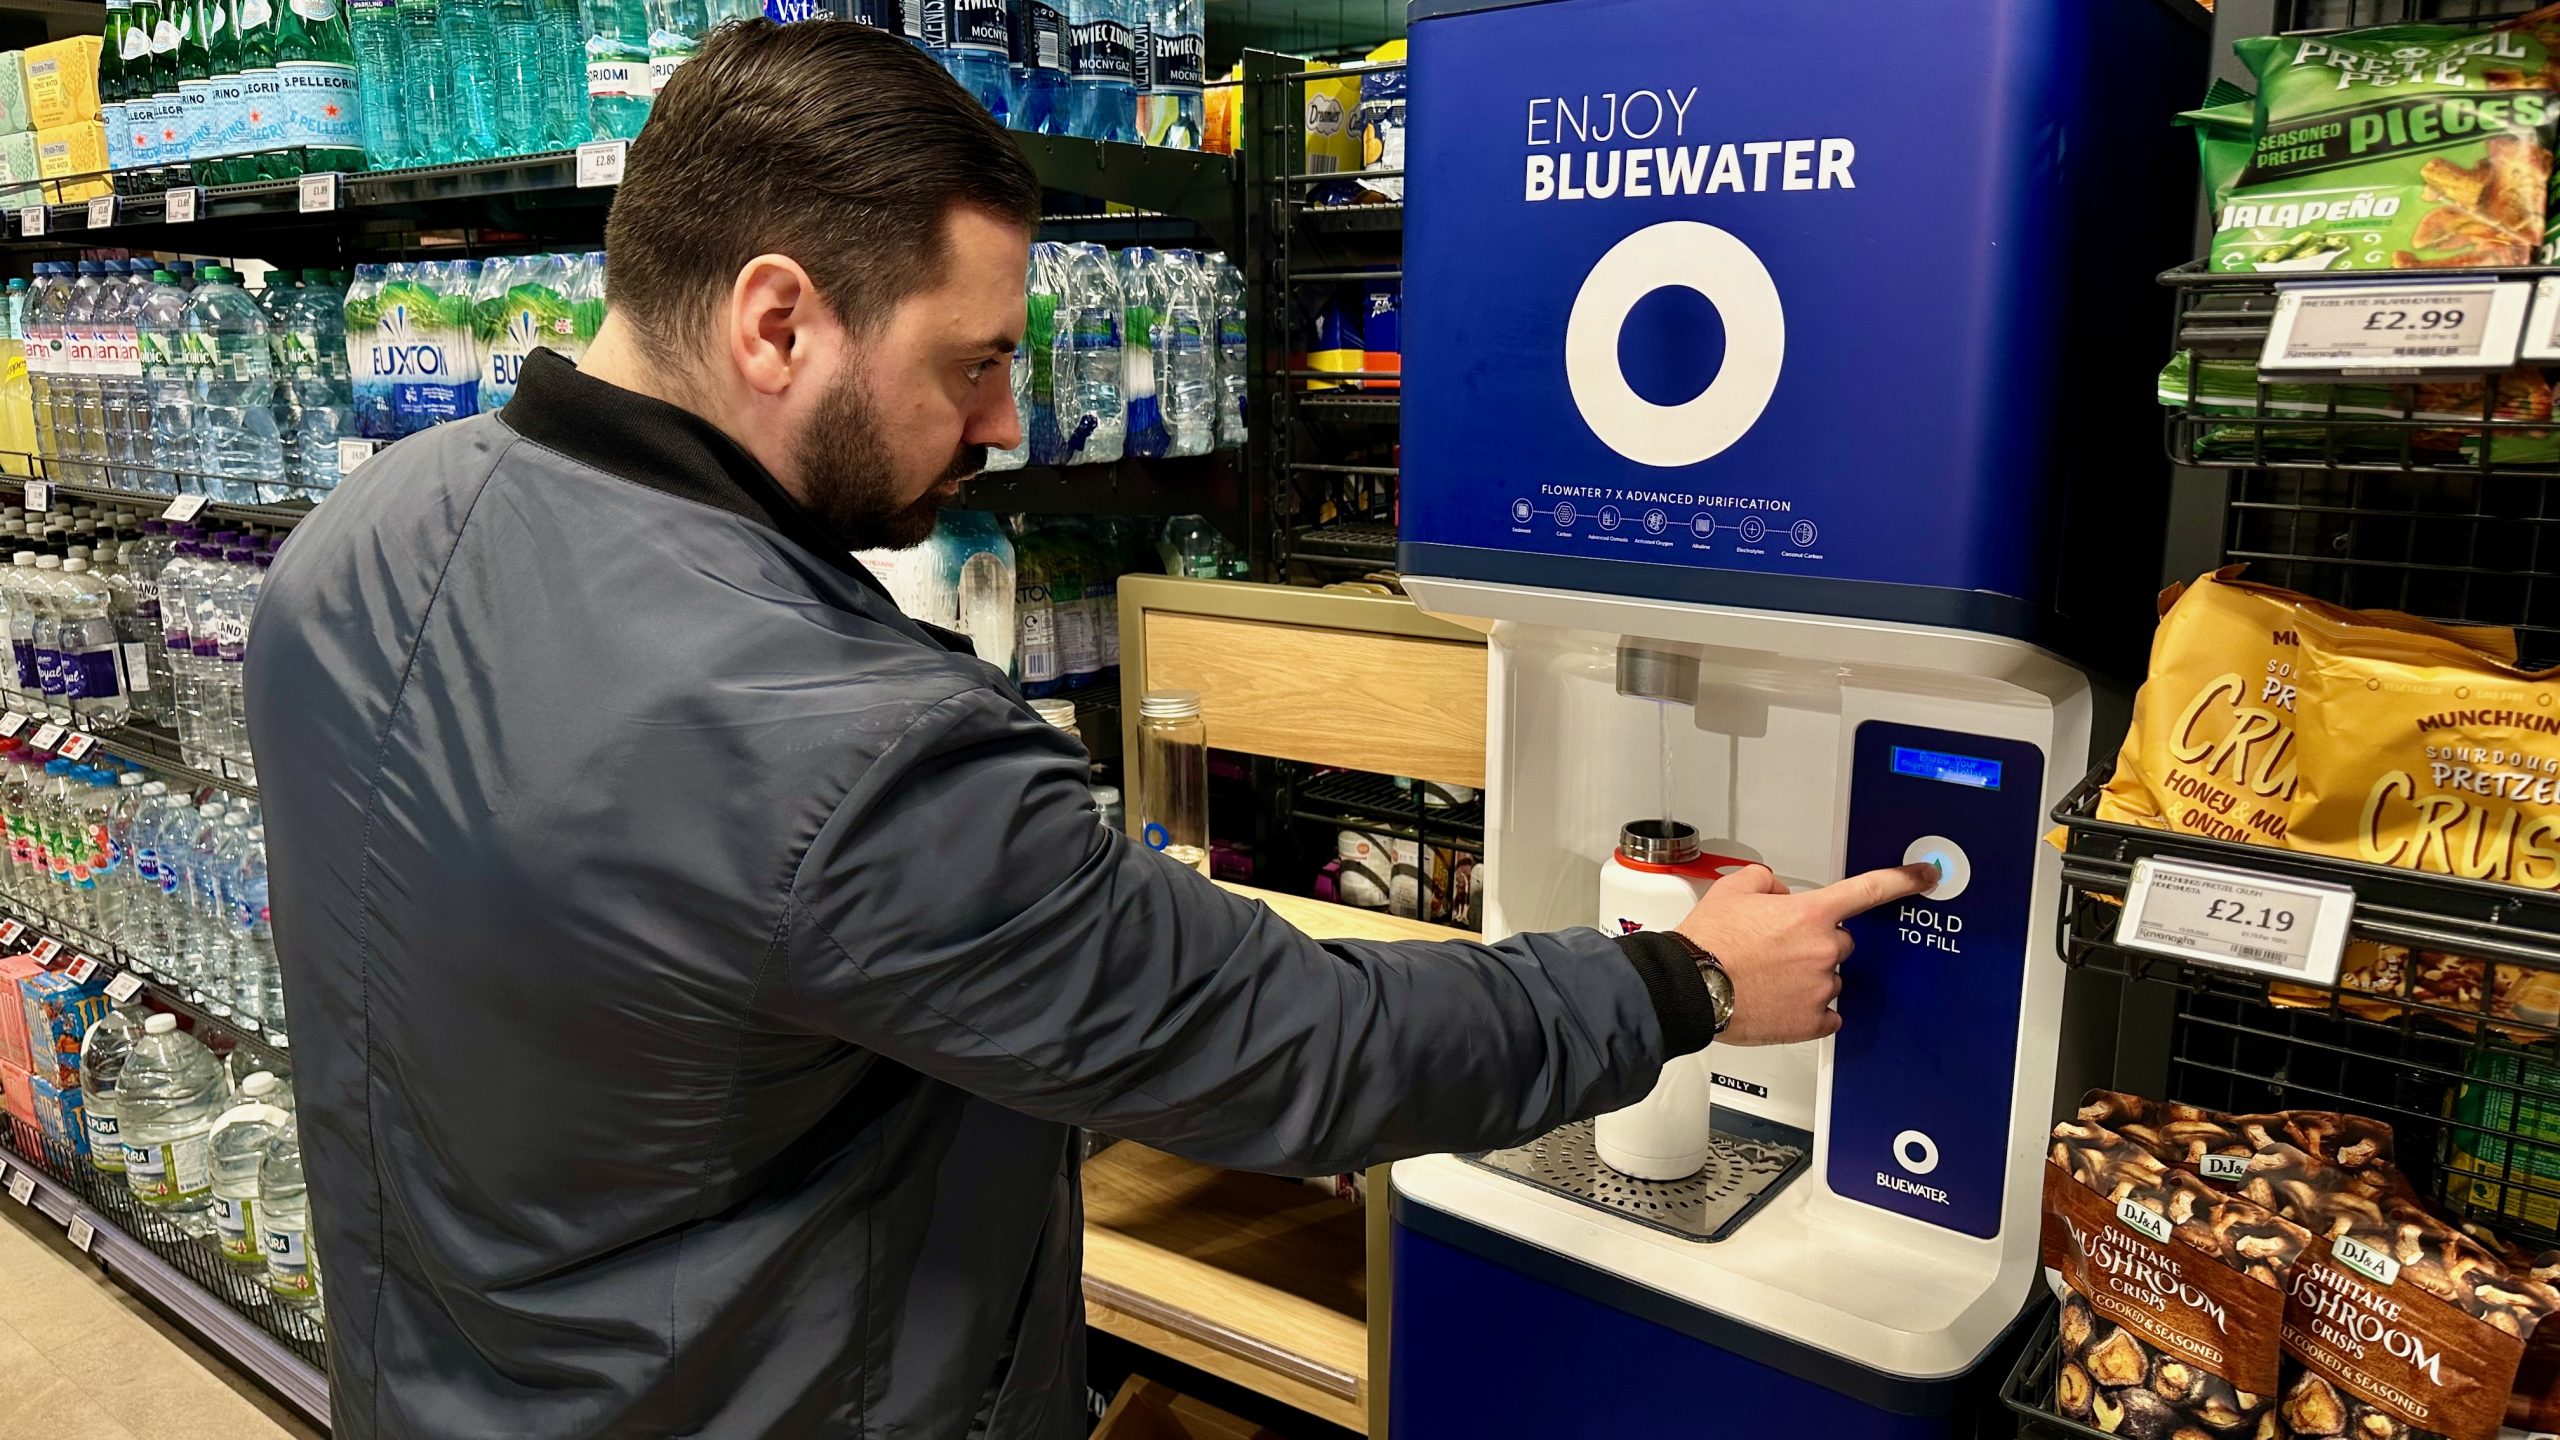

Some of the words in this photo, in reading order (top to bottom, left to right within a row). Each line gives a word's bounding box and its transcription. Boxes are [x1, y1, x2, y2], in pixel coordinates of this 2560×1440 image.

[775, 0, 815, 22] Vyt
[924, 0, 946, 49] RZENIS
[971, 25, 1002, 40] MOCNY
[1070, 24, 1108, 47] YWIEC
[1079, 59, 1115, 70] MOCNY
[1115, 61, 1130, 72] GAZ
[1170, 70, 1198, 82] MOCNY
[1527, 86, 1698, 146] ENJOY
[2350, 95, 2546, 154] PIECES
[2258, 122, 2341, 152] SEASONED
[595, 155, 616, 167] £2.89
[1524, 137, 1857, 202] BLUEWATER
[2257, 143, 2326, 168] PRETZEL
[313, 186, 328, 196] £1.89
[2217, 192, 2401, 232] JALAPEÑO
[2301, 299, 2341, 307] PRETZEL
[2362, 310, 2465, 331] £2.99
[1541, 484, 1601, 498] FLOWATER
[1605, 489, 1612, 499] 7
[1615, 490, 1623, 500] X
[1626, 490, 1694, 505] ADVANCED
[1697, 495, 1791, 512] PURIFICATION
[1556, 530, 1572, 538] Carbon
[1588, 533, 1610, 541] Advanced
[1655, 540, 1674, 548] Oxygen
[1736, 547, 1765, 555] Electrolytes
[2164, 768, 2237, 815] HONEY
[2182, 808, 2251, 844] ONION
[2152, 881, 2201, 895] HONEYMUSTA
[2201, 880, 2234, 893] PRETZEL
[2236, 887, 2263, 898] CRUSH
[1899, 905, 1963, 934] HOLD
[2206, 898, 2295, 933] £2.19
[1899, 928, 1922, 945] TO
[1926, 934, 1961, 954] FILL
[2139, 927, 2196, 946] Kavanaghs
[1717, 1075, 1750, 1092] ONLY
[91, 1118, 117, 1133] PURA
[1876, 1172, 1950, 1206] BLUEWATER
[2123, 1203, 2162, 1237] DJ&A
[2101, 1224, 2182, 1278] SHIITAKE
[2341, 1241, 2386, 1277] DJ&A
[2065, 1215, 2229, 1335] MUSHROOM
[2110, 1277, 2167, 1313] CRISPS
[2307, 1262, 2402, 1322] SHIITAKE
[2096, 1293, 2145, 1325] COOKED
[2144, 1318, 2154, 1331] &
[2154, 1324, 2224, 1364] SEASONED
[2311, 1318, 2366, 1361] CRISPS
[2295, 1334, 2342, 1372] COOKED
[2342, 1366, 2353, 1380] &
[2353, 1372, 2429, 1419] SEASONED
